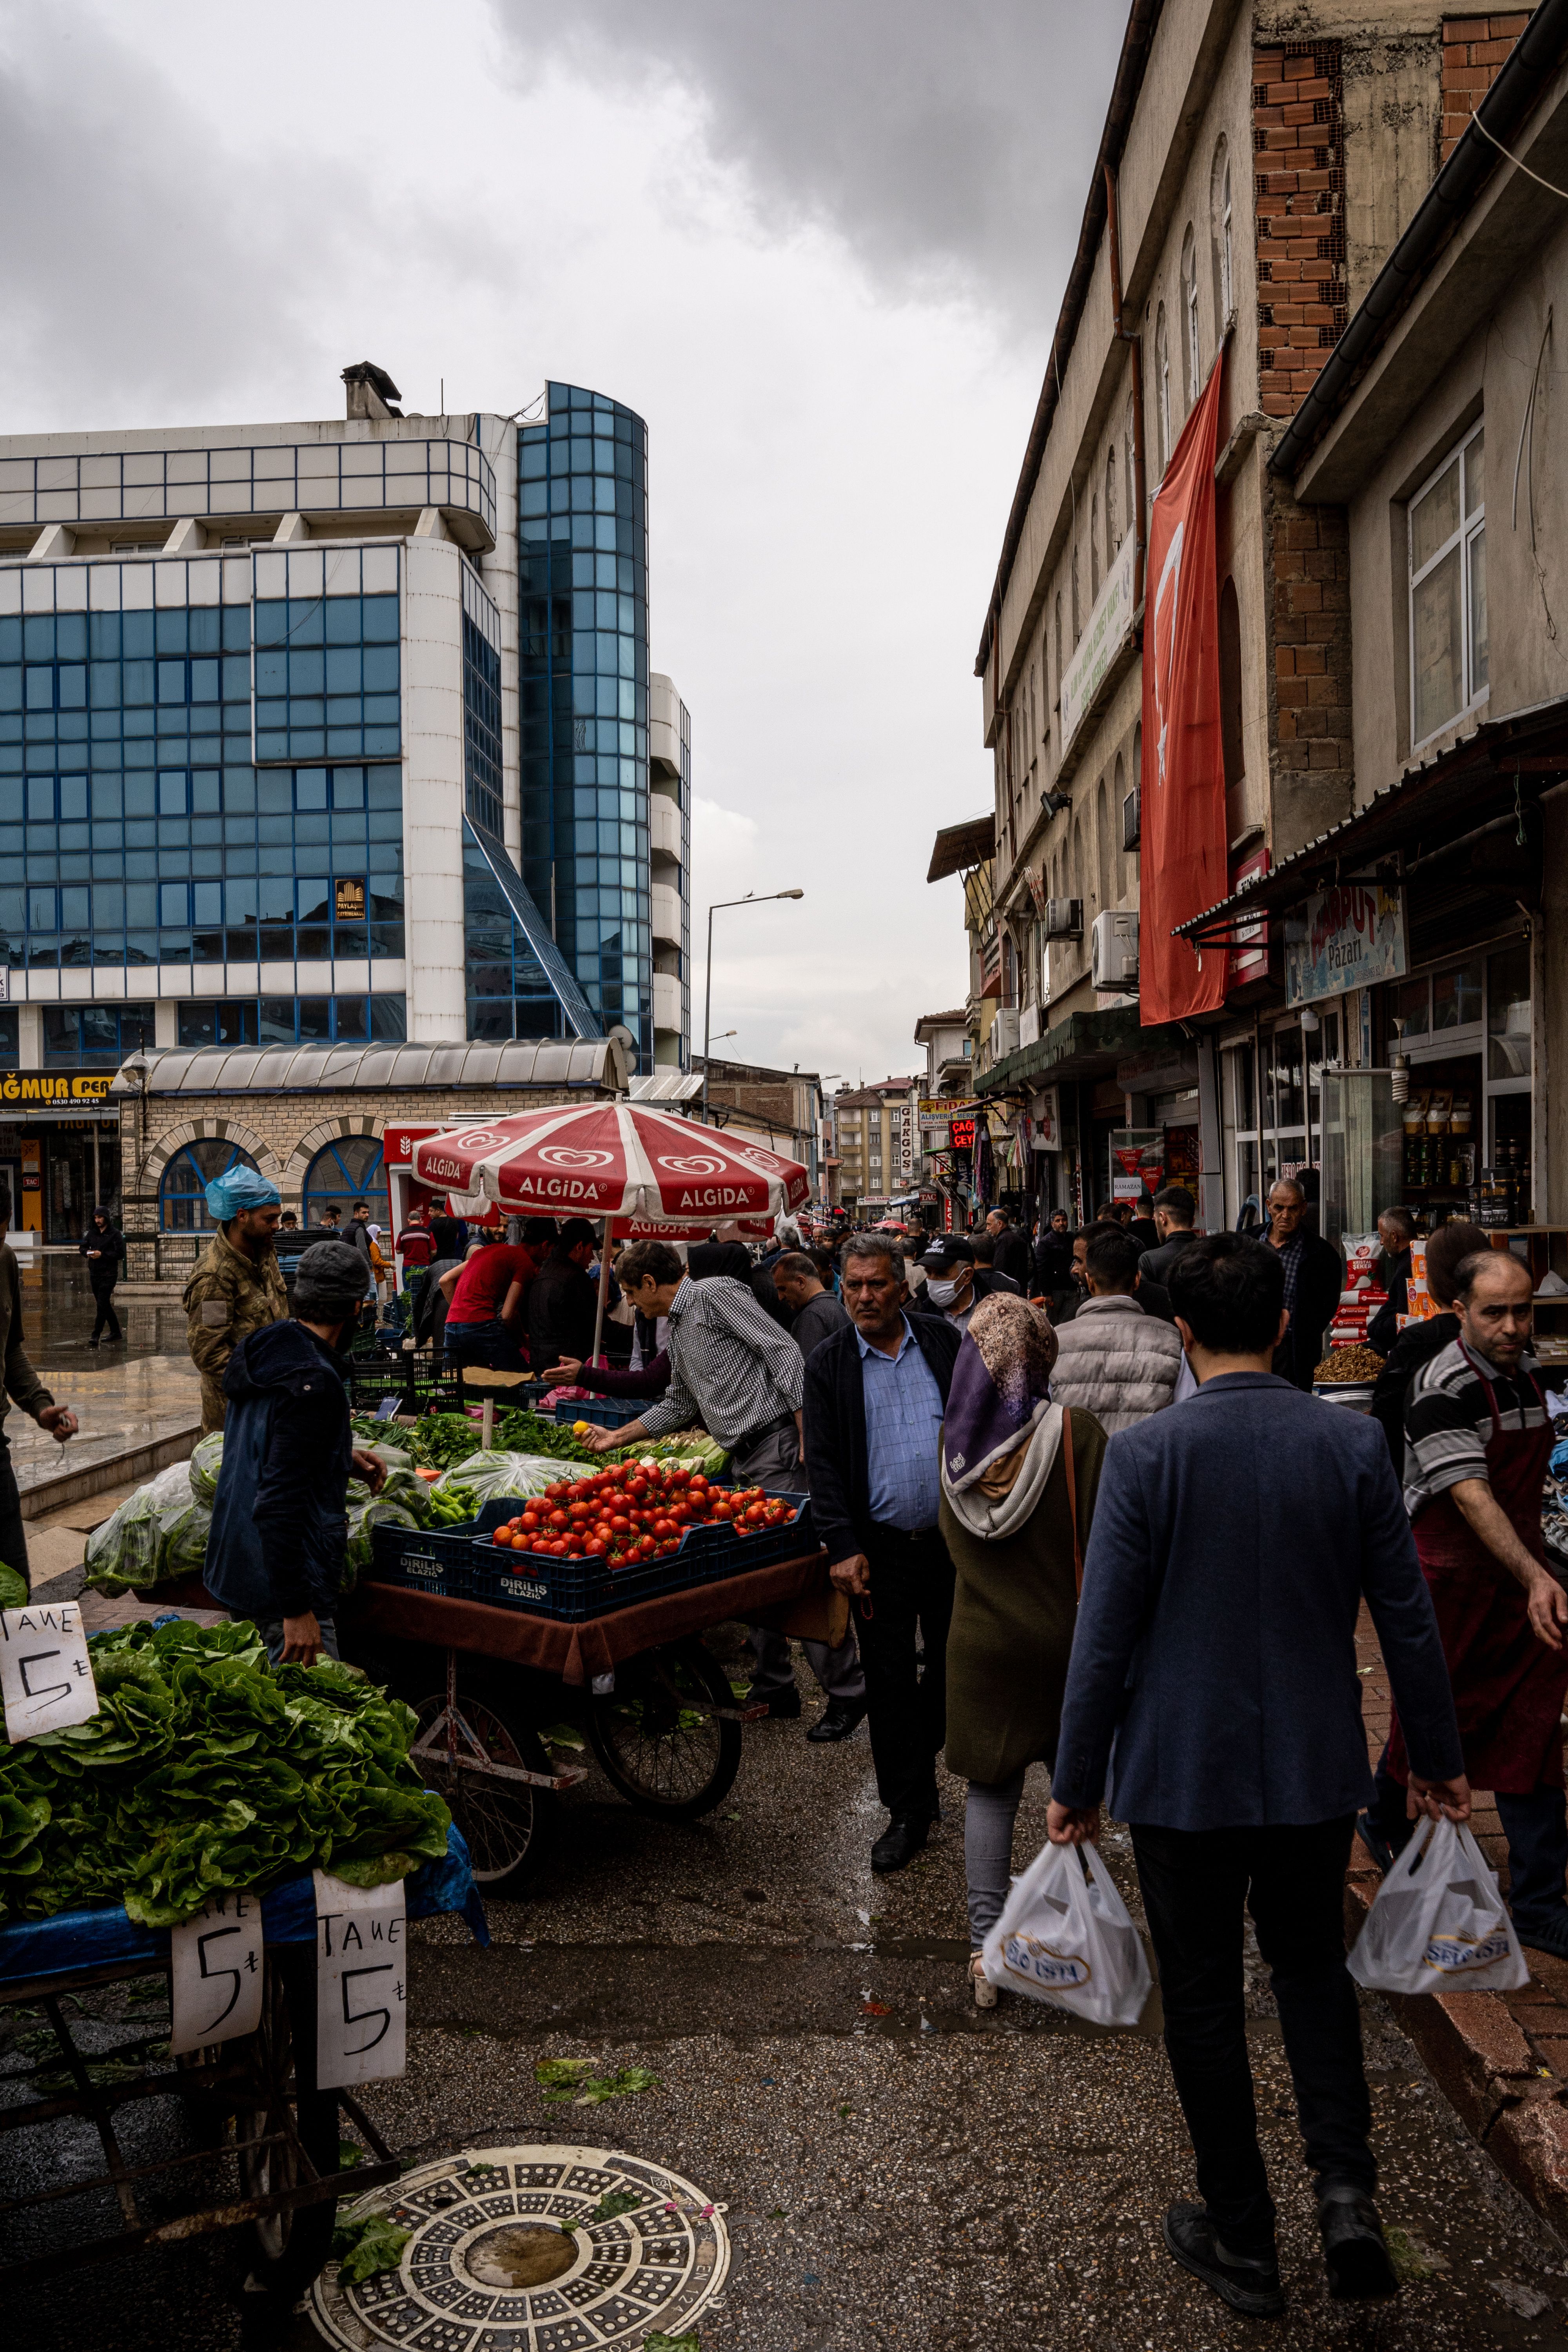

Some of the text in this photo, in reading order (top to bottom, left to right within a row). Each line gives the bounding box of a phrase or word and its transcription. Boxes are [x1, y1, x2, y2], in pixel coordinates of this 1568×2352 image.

[1328, 939, 1362, 971] Pazarı
[0, 1073, 113, 1099] ĞMUR PER
[426, 1157, 460, 1179] ALGiDA
[519, 1176, 599, 1200] ALGiDA
[681, 1187, 750, 1208] ALGiDA
[1115, 1184, 1142, 1193] RAMAZAN
[19, 1650, 72, 1715] 5
[197, 1926, 241, 2036] 5
[341, 1964, 394, 2056] 5
[692, 2265, 711, 2281] EN
[672, 2289, 698, 2312] 124
